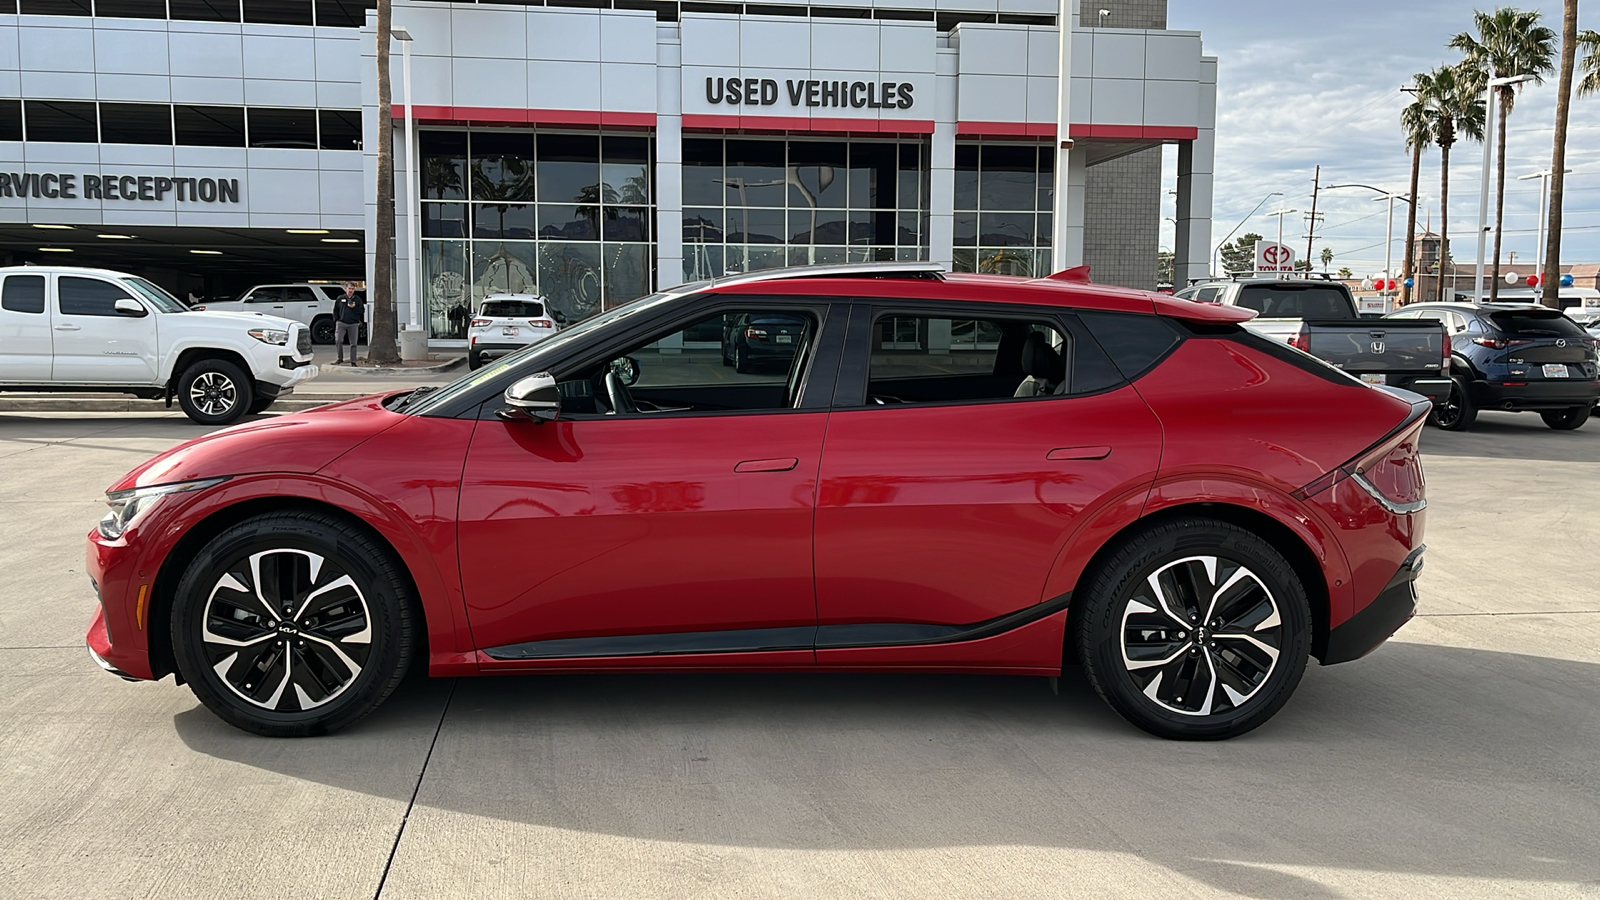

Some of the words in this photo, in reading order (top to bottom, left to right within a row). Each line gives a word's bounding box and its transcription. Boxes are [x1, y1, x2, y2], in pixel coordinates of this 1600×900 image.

[706, 77, 778, 105] USED
[786, 79, 915, 109] VEHICLES
[83, 175, 239, 203] RECEPTION
[1102, 547, 1164, 629] CONTINENTAL
